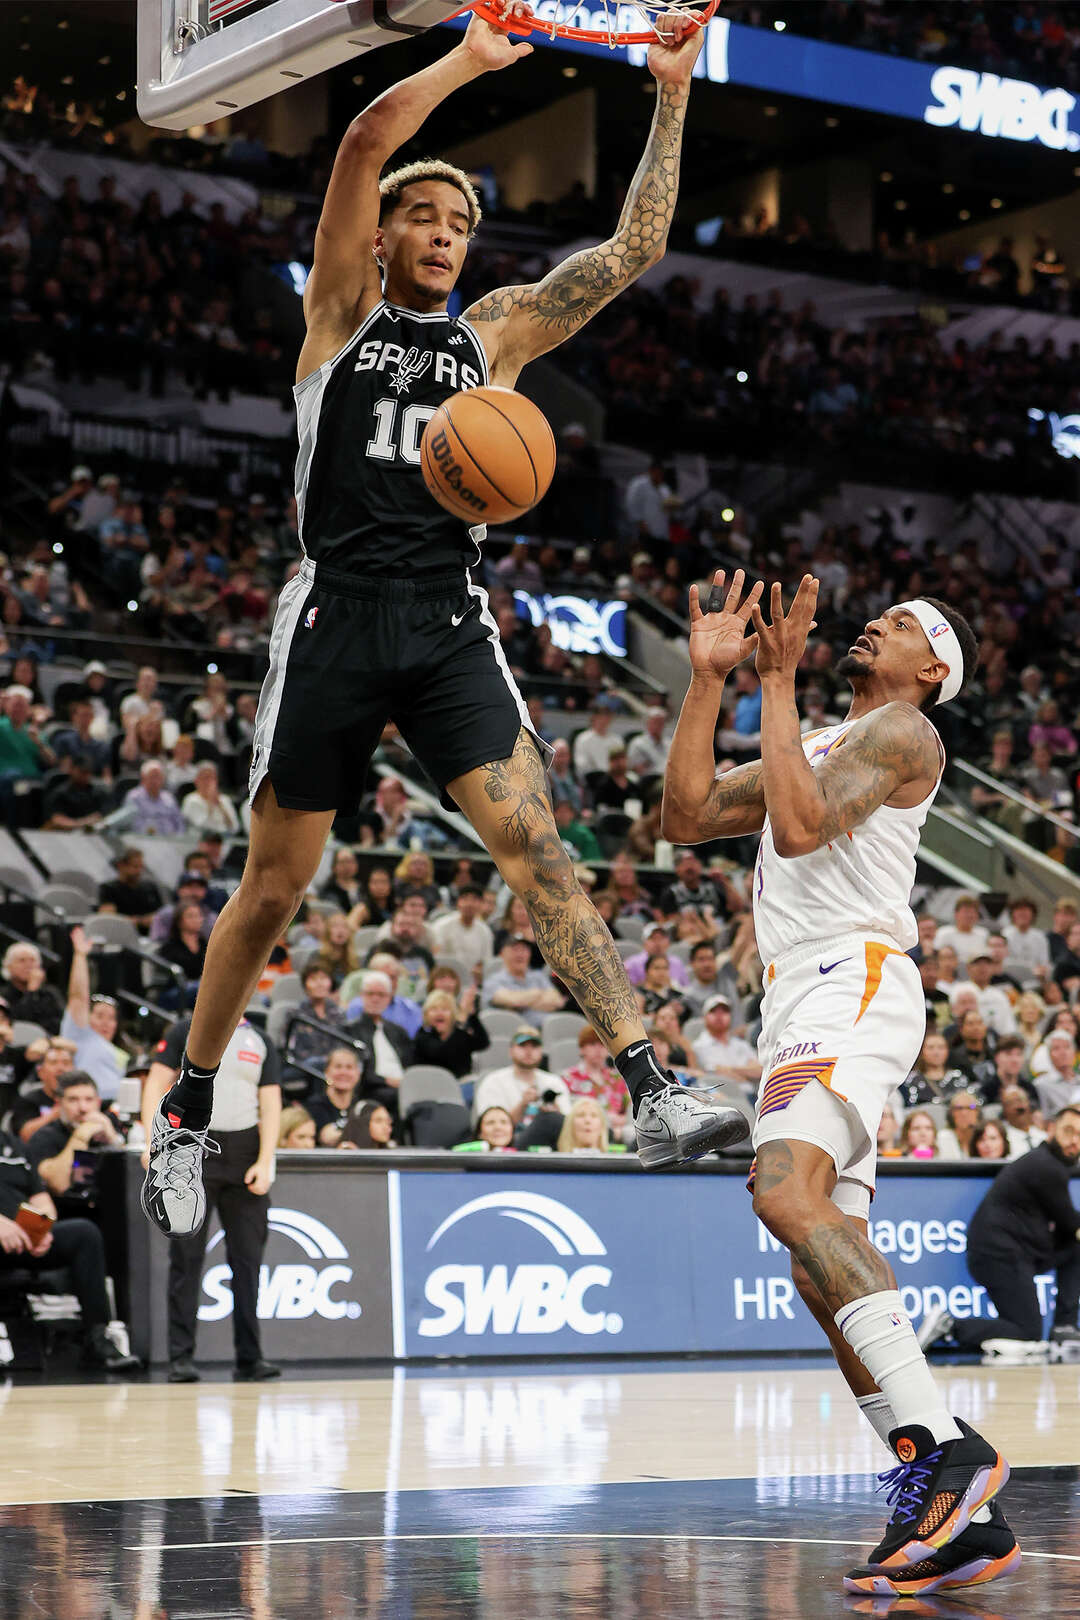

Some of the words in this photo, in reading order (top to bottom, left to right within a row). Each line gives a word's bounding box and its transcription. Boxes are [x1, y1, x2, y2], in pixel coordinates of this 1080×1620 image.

[924, 66, 1077, 150] SWBC
[354, 340, 480, 393] SPURS
[365, 397, 439, 465] 10
[431, 428, 489, 512] Wilson
[418, 1263, 613, 1337] SWBC
[733, 1277, 796, 1321] HR
